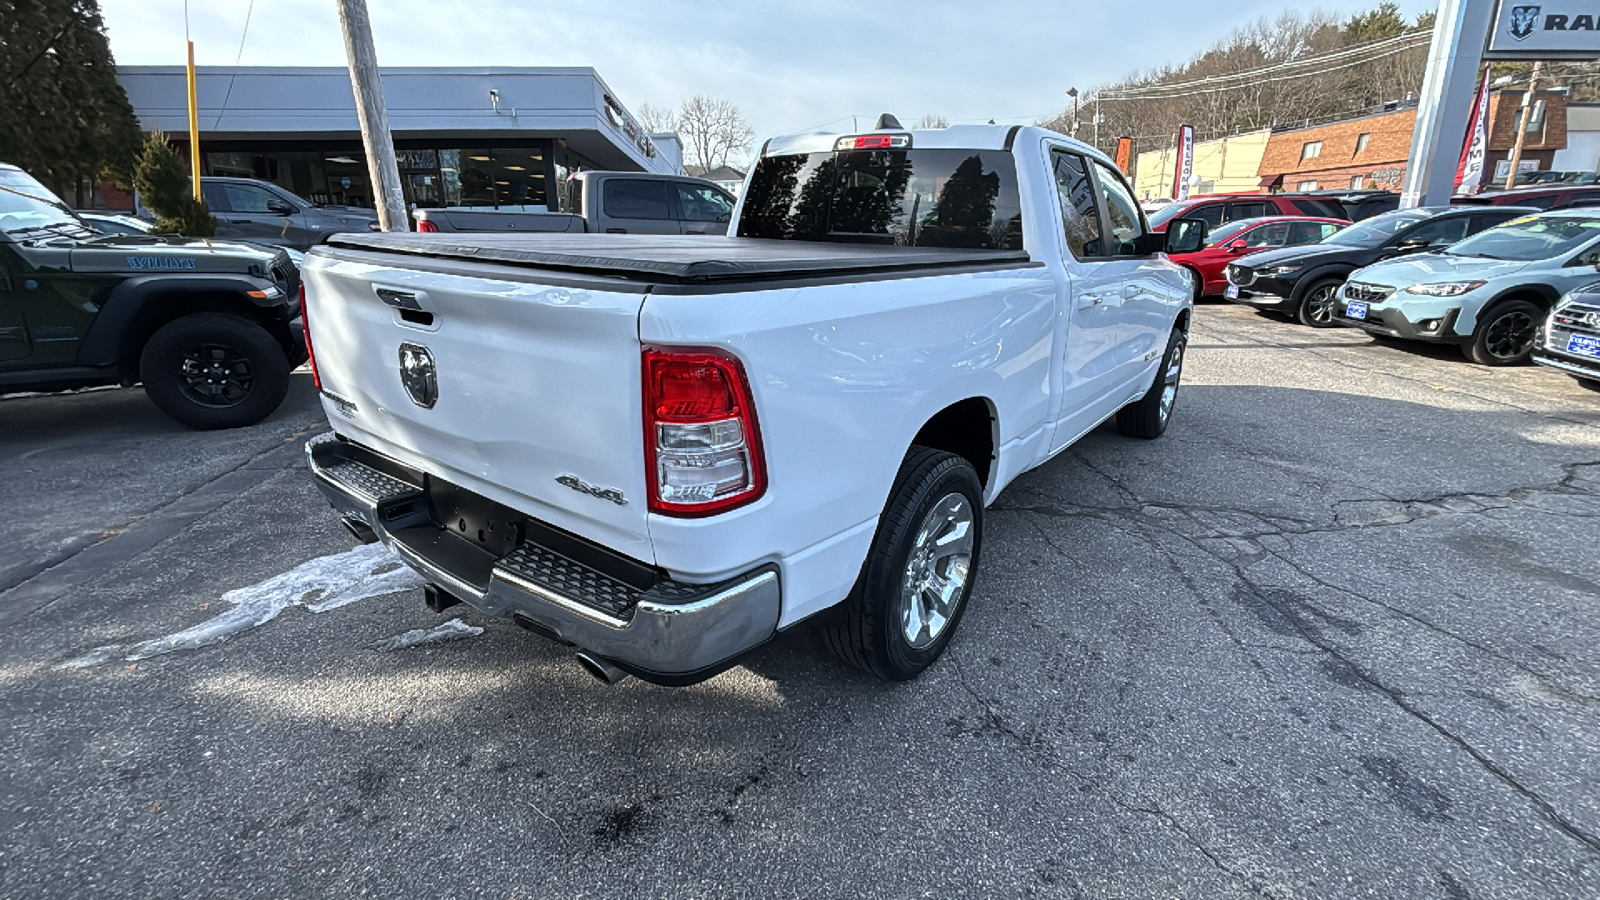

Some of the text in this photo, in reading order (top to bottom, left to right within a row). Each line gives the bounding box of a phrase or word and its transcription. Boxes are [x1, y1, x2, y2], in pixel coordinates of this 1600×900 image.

[1543, 14, 1600, 31] RA
[1182, 136, 1191, 190] WELCOME
[127, 257, 196, 269] WILLYS
